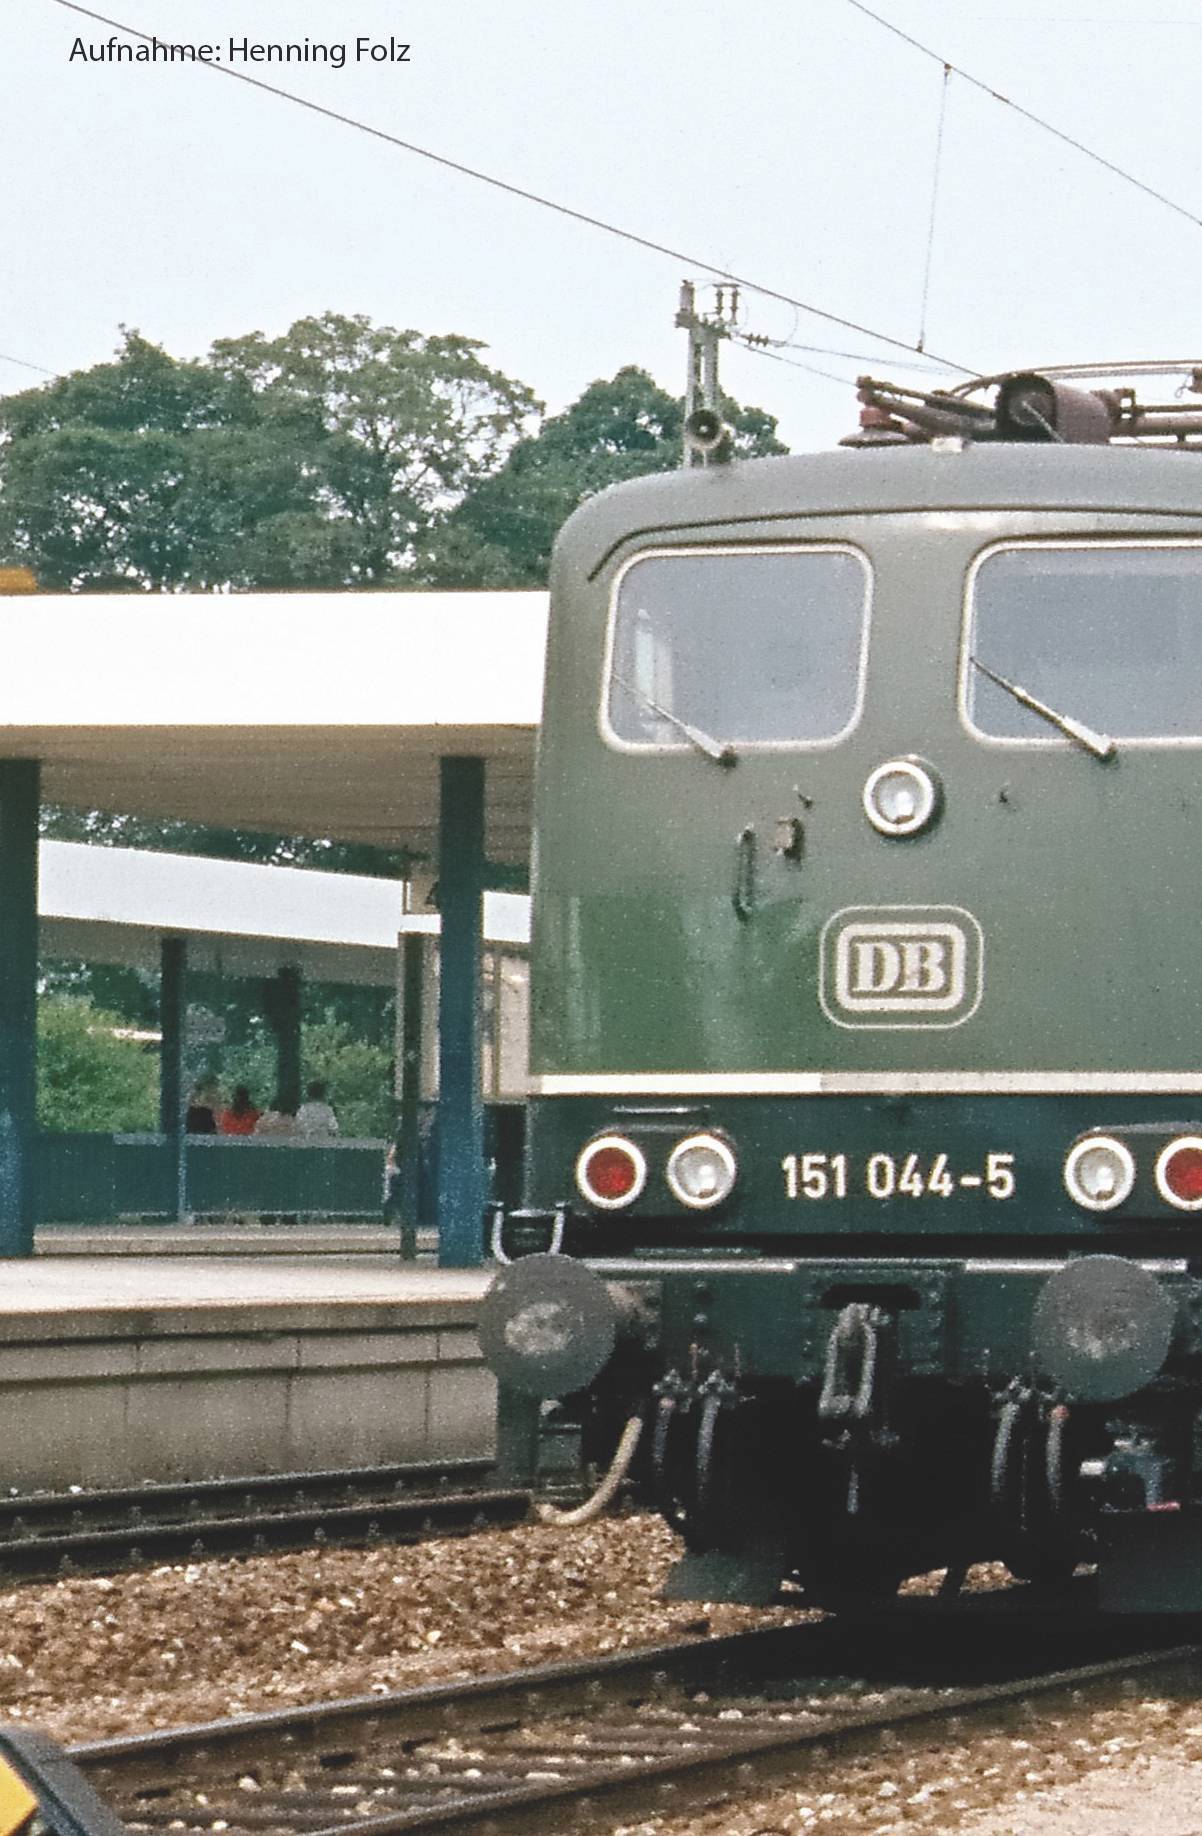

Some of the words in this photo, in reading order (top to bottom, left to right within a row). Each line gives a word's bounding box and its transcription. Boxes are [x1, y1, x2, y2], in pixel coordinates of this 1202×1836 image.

[851, 942, 946, 992] DB
[781, 1153, 847, 1199] 151
[867, 1152, 1016, 1199] 044-5
